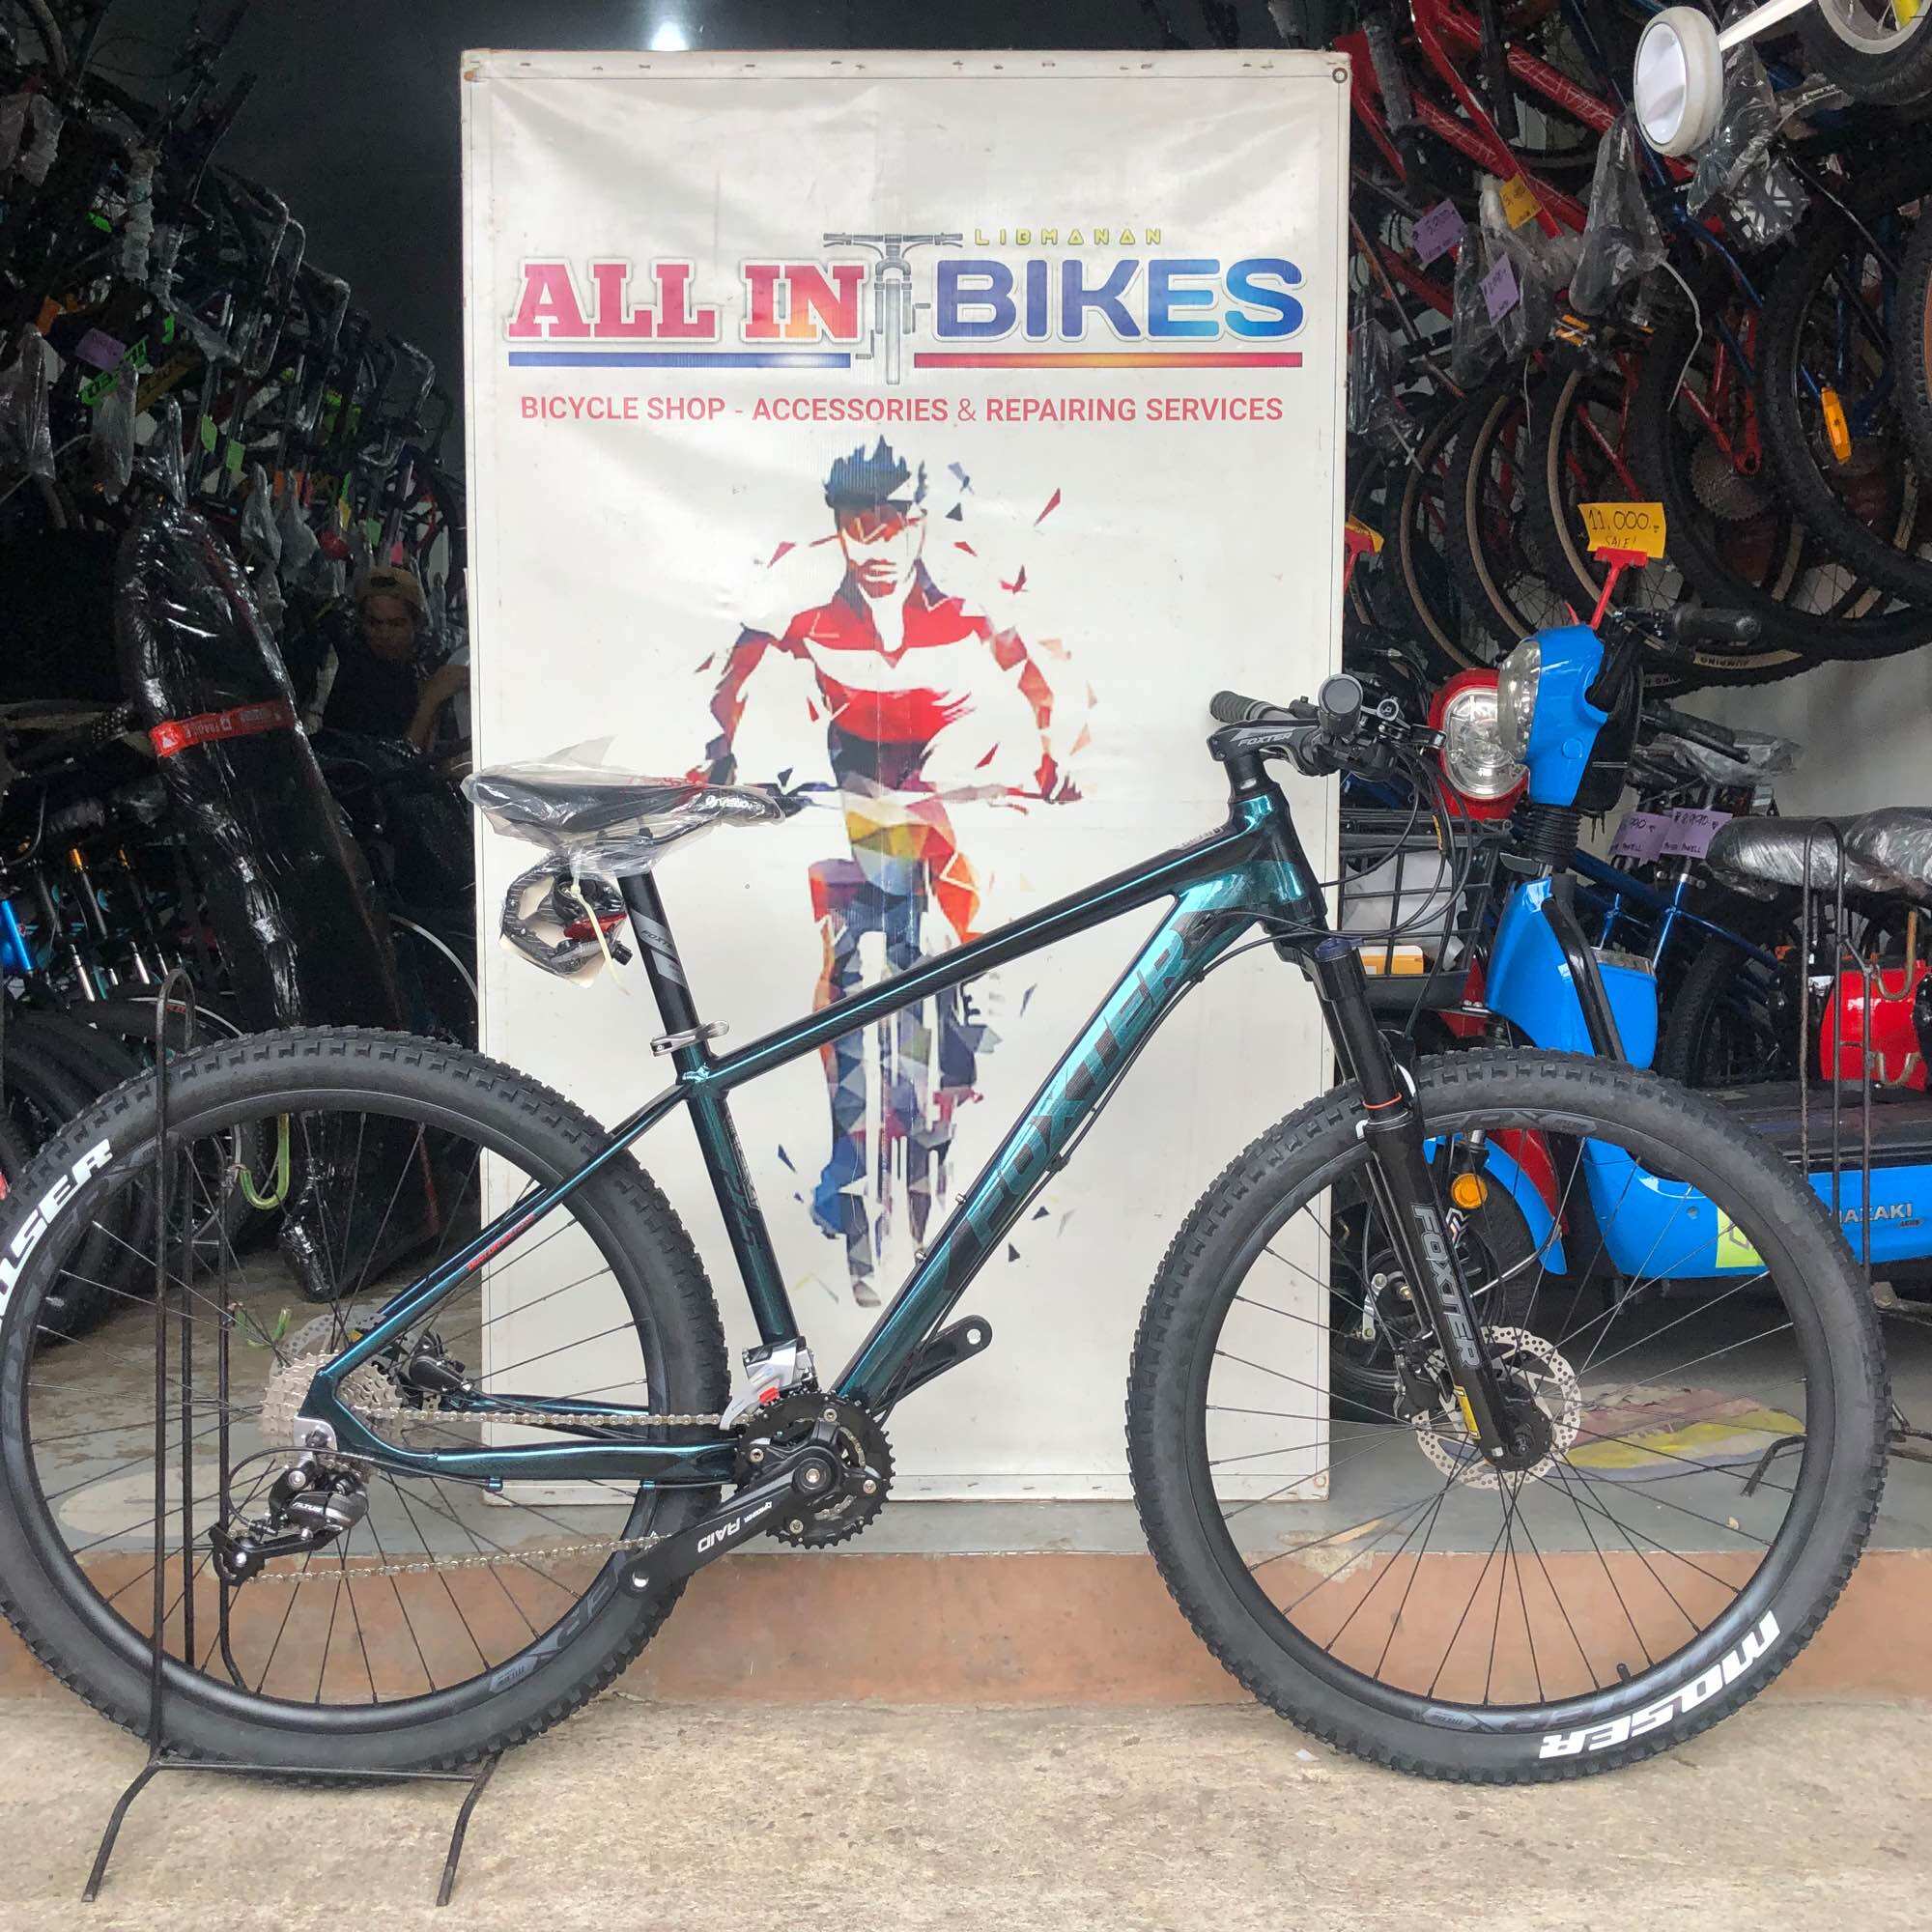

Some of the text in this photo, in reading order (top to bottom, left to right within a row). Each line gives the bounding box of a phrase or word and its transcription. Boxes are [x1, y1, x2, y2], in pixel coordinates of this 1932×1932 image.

[974, 228, 1163, 246] LIBMANAN
[505, 257, 1305, 341] ALL IN BIKES
[520, 395, 639, 420] BICYCLE
[646, 396, 725, 421] SHOP
[752, 397, 949, 421] ACCESSORIES
[956, 397, 977, 422] &
[985, 397, 1136, 422] REPAIRING
[1145, 396, 1284, 421] SERVICES
[1236, 731, 1293, 747] FOXTER
[968, 927, 1188, 1248] FOXTER
[1829, 1203, 1913, 1224] AZAKI
[1411, 1205, 1482, 1369] FOXTER
[696, 1517, 741, 1554] RAID
[1537, 1609, 1781, 1760] MOSER
